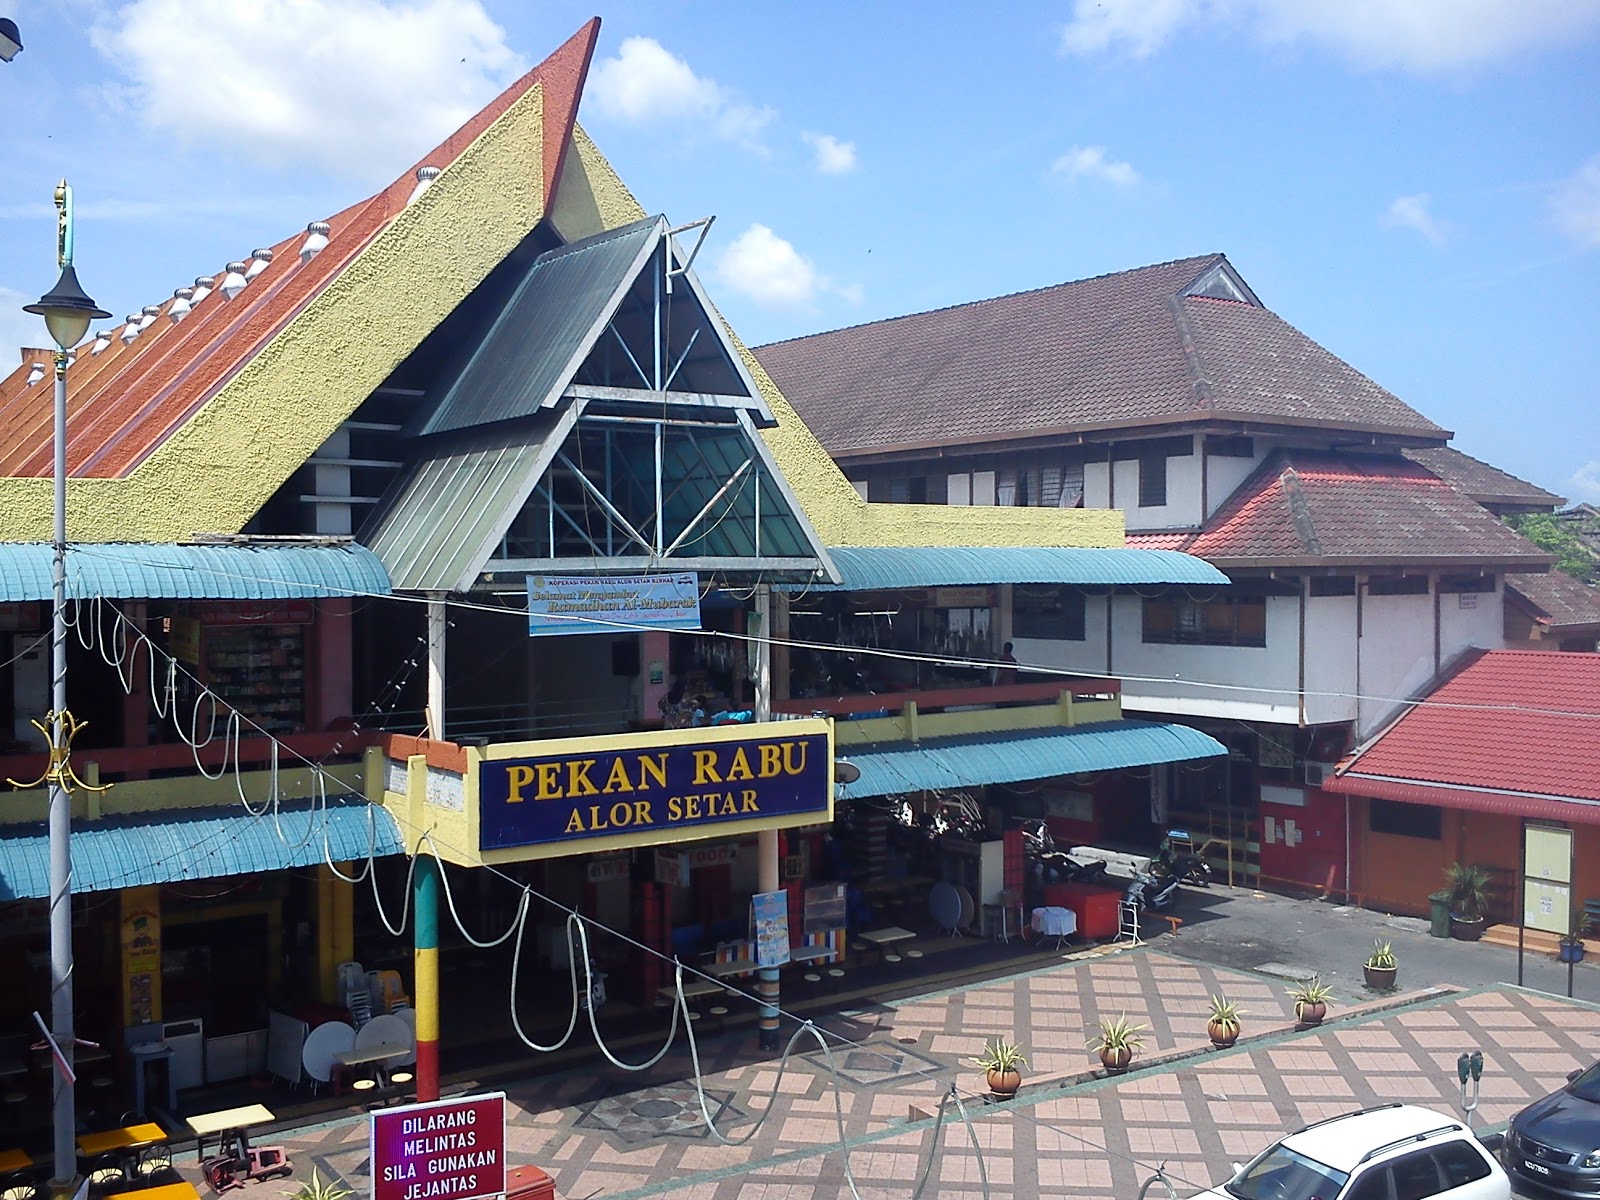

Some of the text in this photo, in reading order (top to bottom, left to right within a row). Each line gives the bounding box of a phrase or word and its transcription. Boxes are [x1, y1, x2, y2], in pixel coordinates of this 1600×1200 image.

[533, 591, 577, 601] Selamat
[547, 596, 697, 613] Ramadhan Al-Mubarak
[505, 740, 810, 804] PEKAN RABU
[564, 789, 760, 834] ALOR SETAR
[403, 1110, 476, 1135] DILARANG
[404, 1132, 476, 1157] MELINTAS
[383, 1150, 496, 1181] SILA GUNAKAN
[403, 1175, 477, 1200] JEJANTAS
